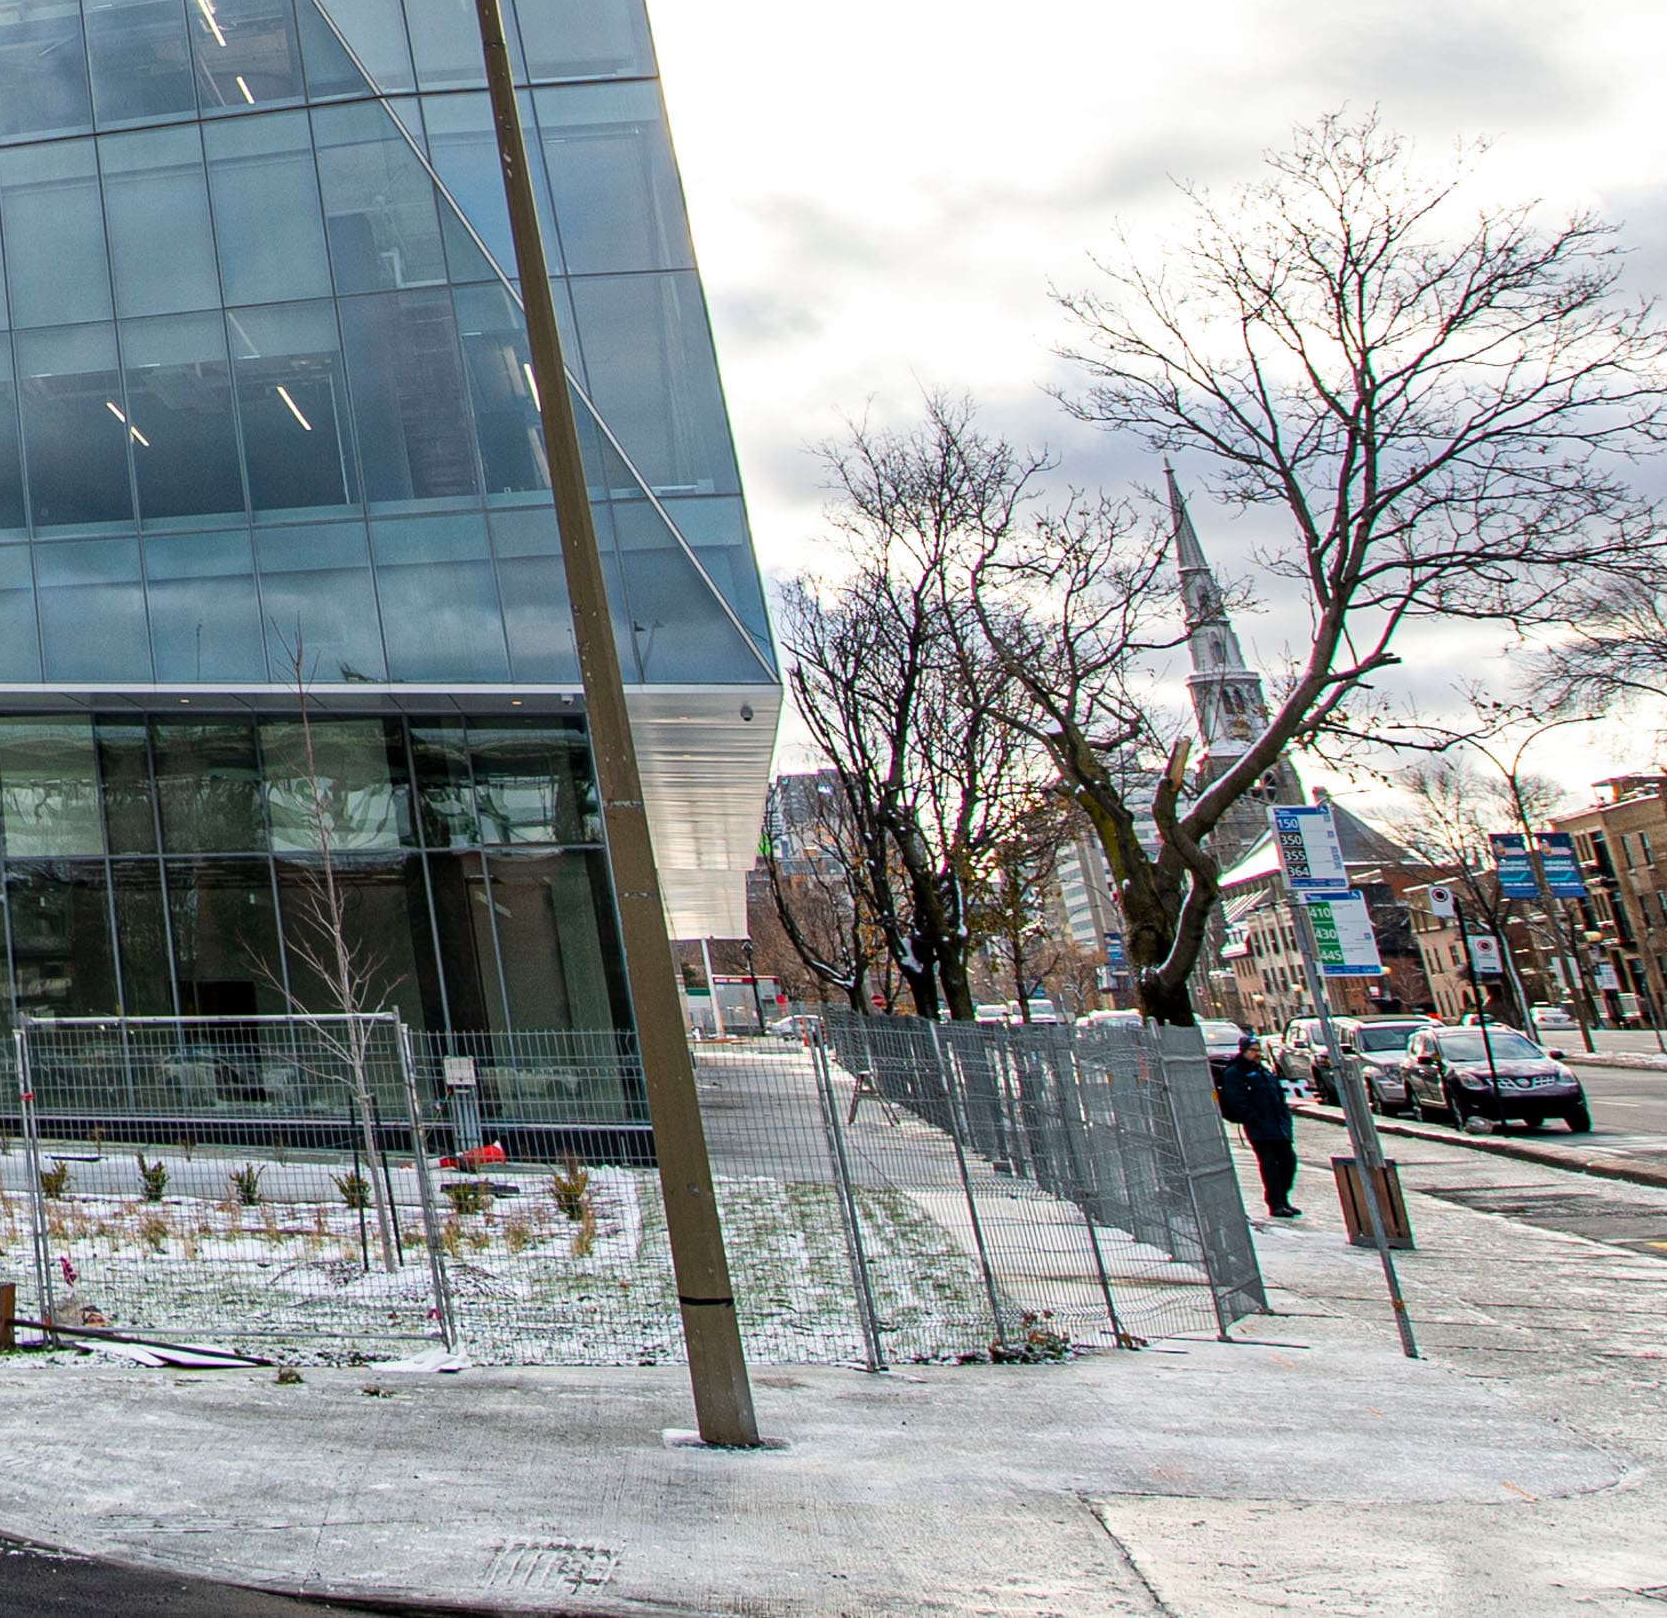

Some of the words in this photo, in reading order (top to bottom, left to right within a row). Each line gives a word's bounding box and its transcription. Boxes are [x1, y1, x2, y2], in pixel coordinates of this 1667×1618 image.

[1277, 818, 1298, 829] 150
[1281, 835, 1302, 845] 350
[1284, 850, 1306, 861] 355
[1288, 866, 1309, 877] 364
[1309, 907, 1332, 918] 410
[1315, 928, 1337, 939] 430
[1321, 950, 1342, 960] 445
